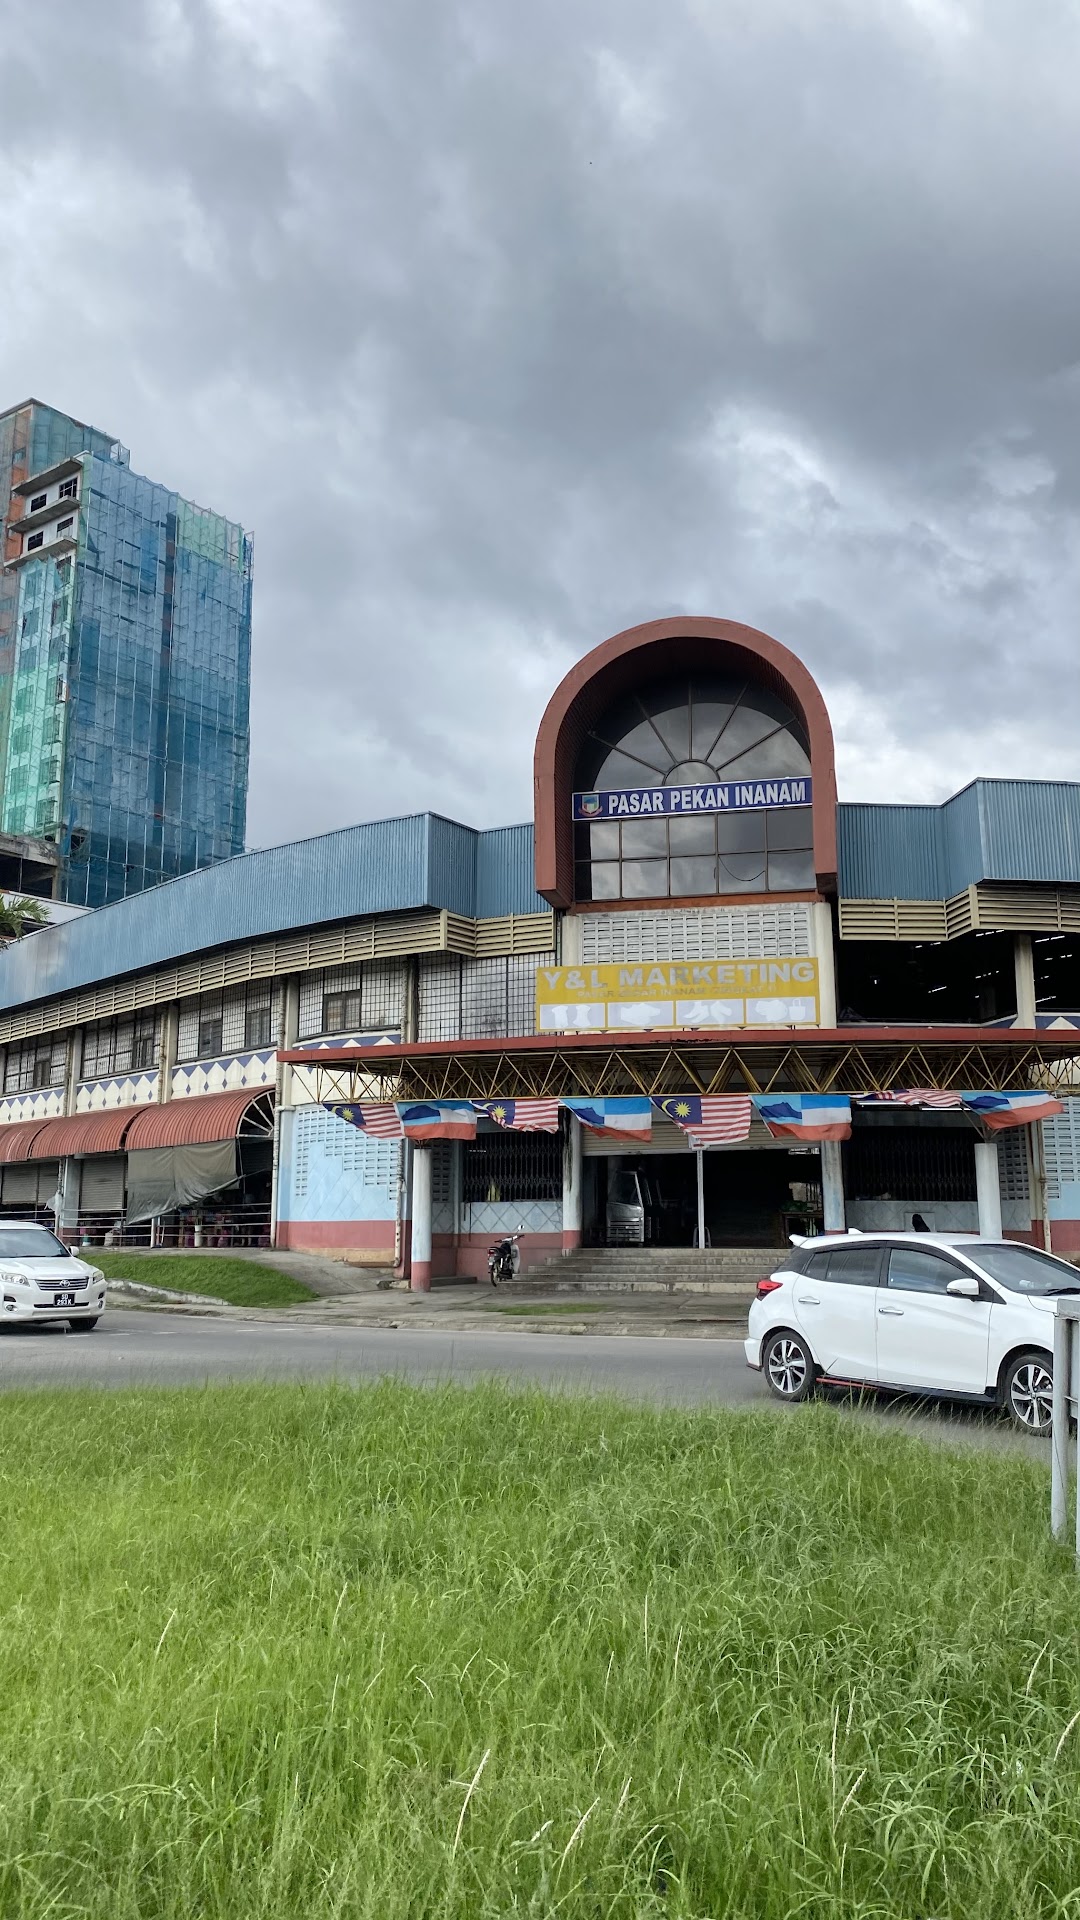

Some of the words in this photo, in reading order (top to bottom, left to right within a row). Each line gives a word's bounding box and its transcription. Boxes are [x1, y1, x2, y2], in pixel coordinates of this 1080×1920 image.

[608, 794, 664, 814] PASAR
[670, 787, 729, 810] PEKAN
[735, 782, 806, 804] INANAM
[619, 962, 815, 988] MARKETING
